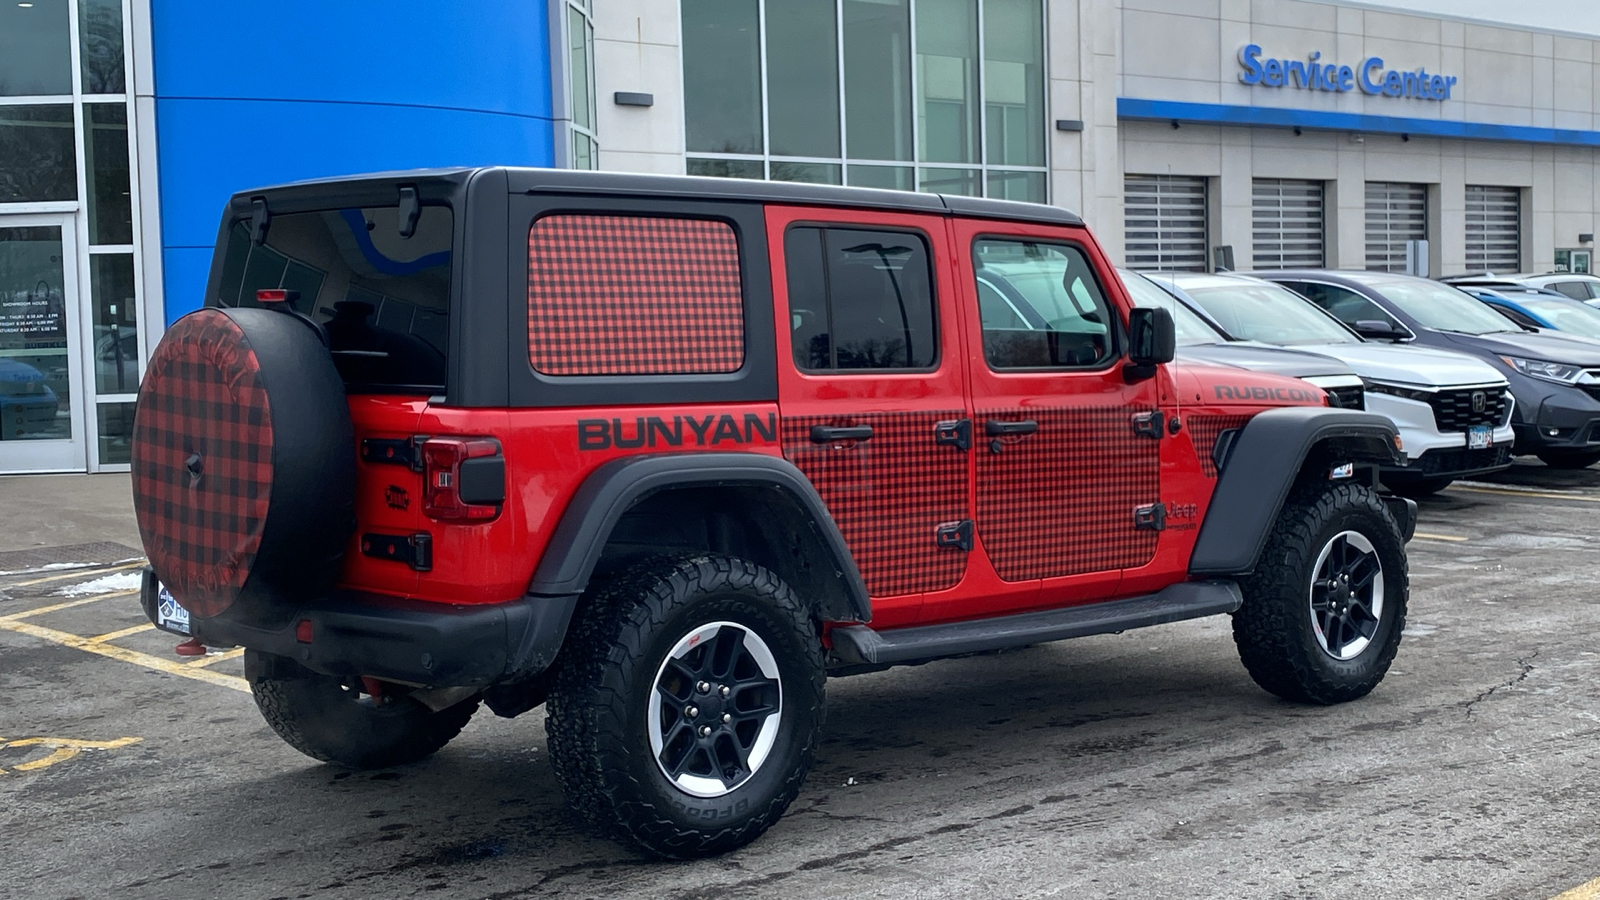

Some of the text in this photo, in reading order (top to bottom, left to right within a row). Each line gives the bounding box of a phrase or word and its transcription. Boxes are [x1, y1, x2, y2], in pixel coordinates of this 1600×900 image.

[1238, 44, 1457, 100] Service Center
[1213, 384, 1320, 403] RUBICON
[577, 412, 777, 451] BUNYAN
[1166, 500, 1197, 521] Jeep
